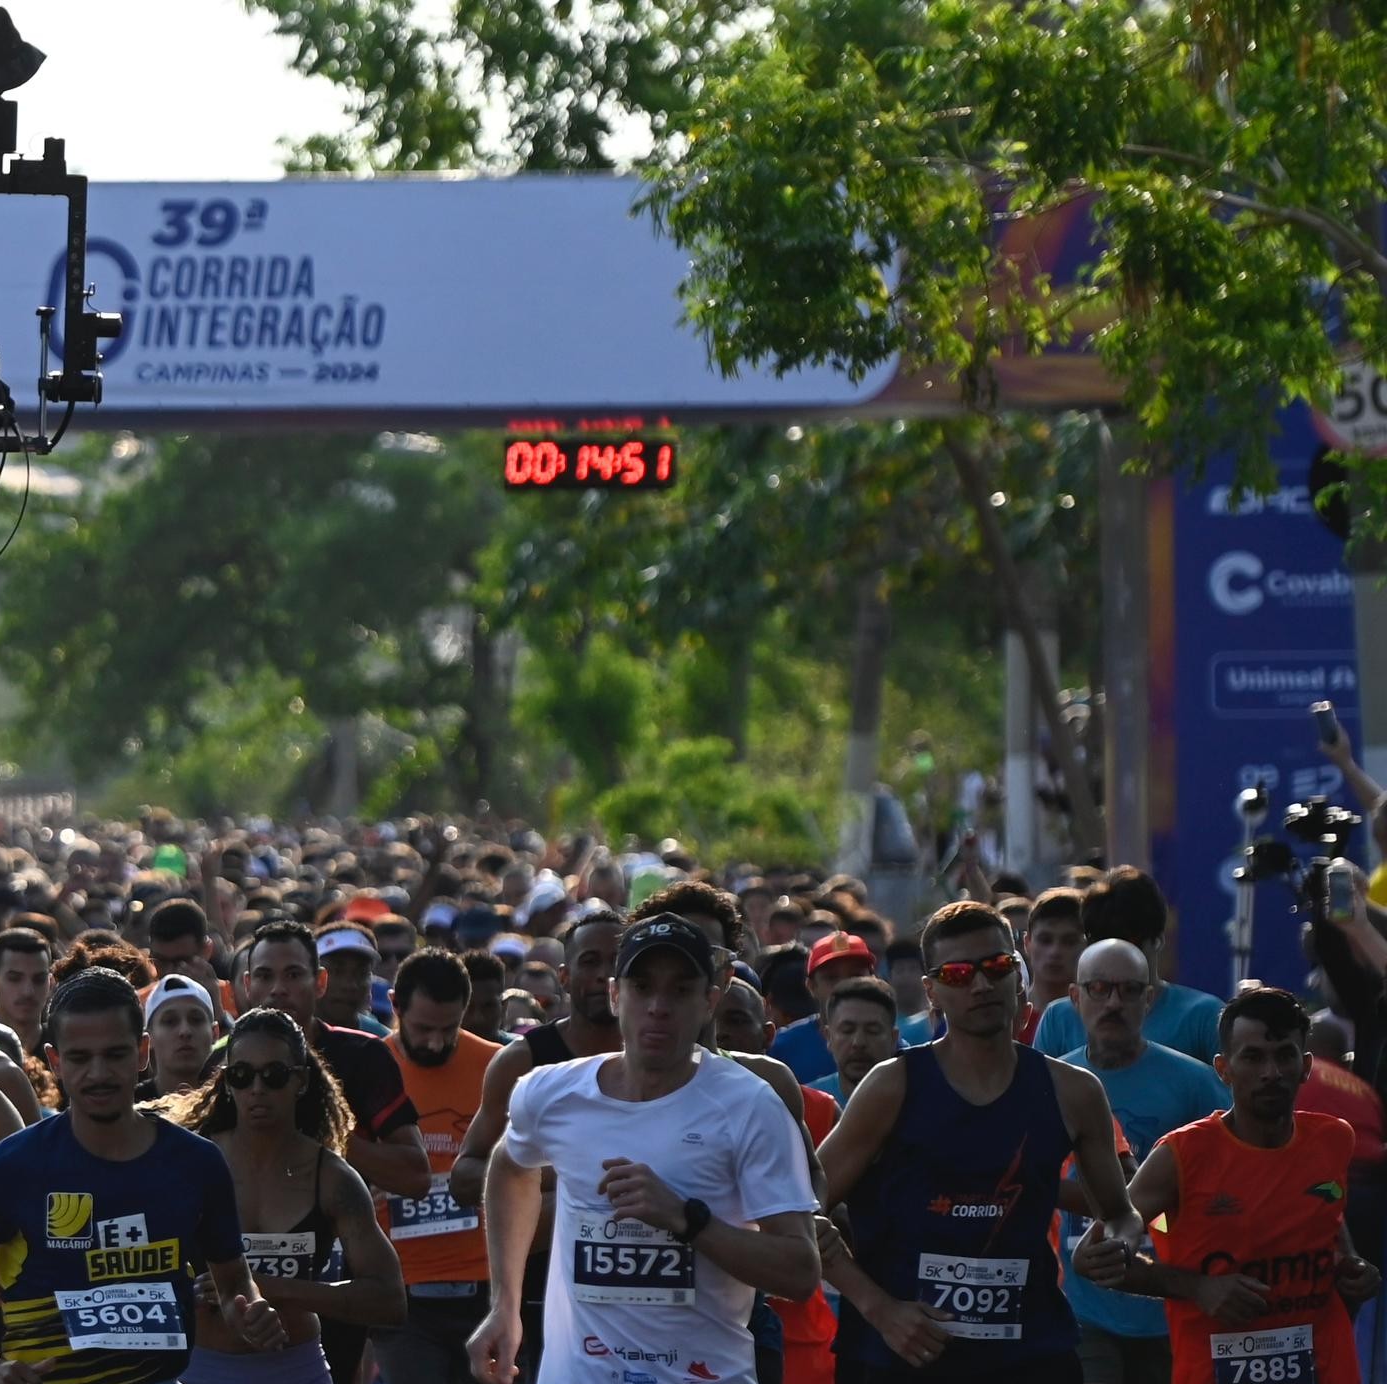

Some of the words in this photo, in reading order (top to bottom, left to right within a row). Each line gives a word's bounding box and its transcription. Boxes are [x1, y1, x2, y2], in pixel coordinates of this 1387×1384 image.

[147, 256, 314, 299] CORRIDA
[139, 295, 385, 357] INTEGRAÇÃO
[136, 362, 270, 383] CAMPINAS
[313, 361, 379, 383] 2024
[1267, 569, 1349, 597] Covab
[1227, 665, 1326, 691] Unimed
[103, 1218, 120, 1248] É
[580, 1225, 595, 1239] 5K
[47, 1239, 91, 1249] MAGÁRIO
[291, 1242, 308, 1253] 5K
[90, 1245, 174, 1278] SAÚDE
[584, 1245, 681, 1276] 15572
[925, 1266, 944, 1278] 5K
[1003, 1271, 1019, 1283] 5K
[65, 1299, 81, 1307] 5K
[149, 1290, 166, 1300] 5K
[933, 1284, 1010, 1313] 7092
[78, 1304, 167, 1326] 5604
[1217, 1343, 1233, 1355] 5K
[1293, 1337, 1307, 1349] 5K
[614, 1346, 678, 1367] Kalenji
[1230, 1354, 1301, 1384] 7885
